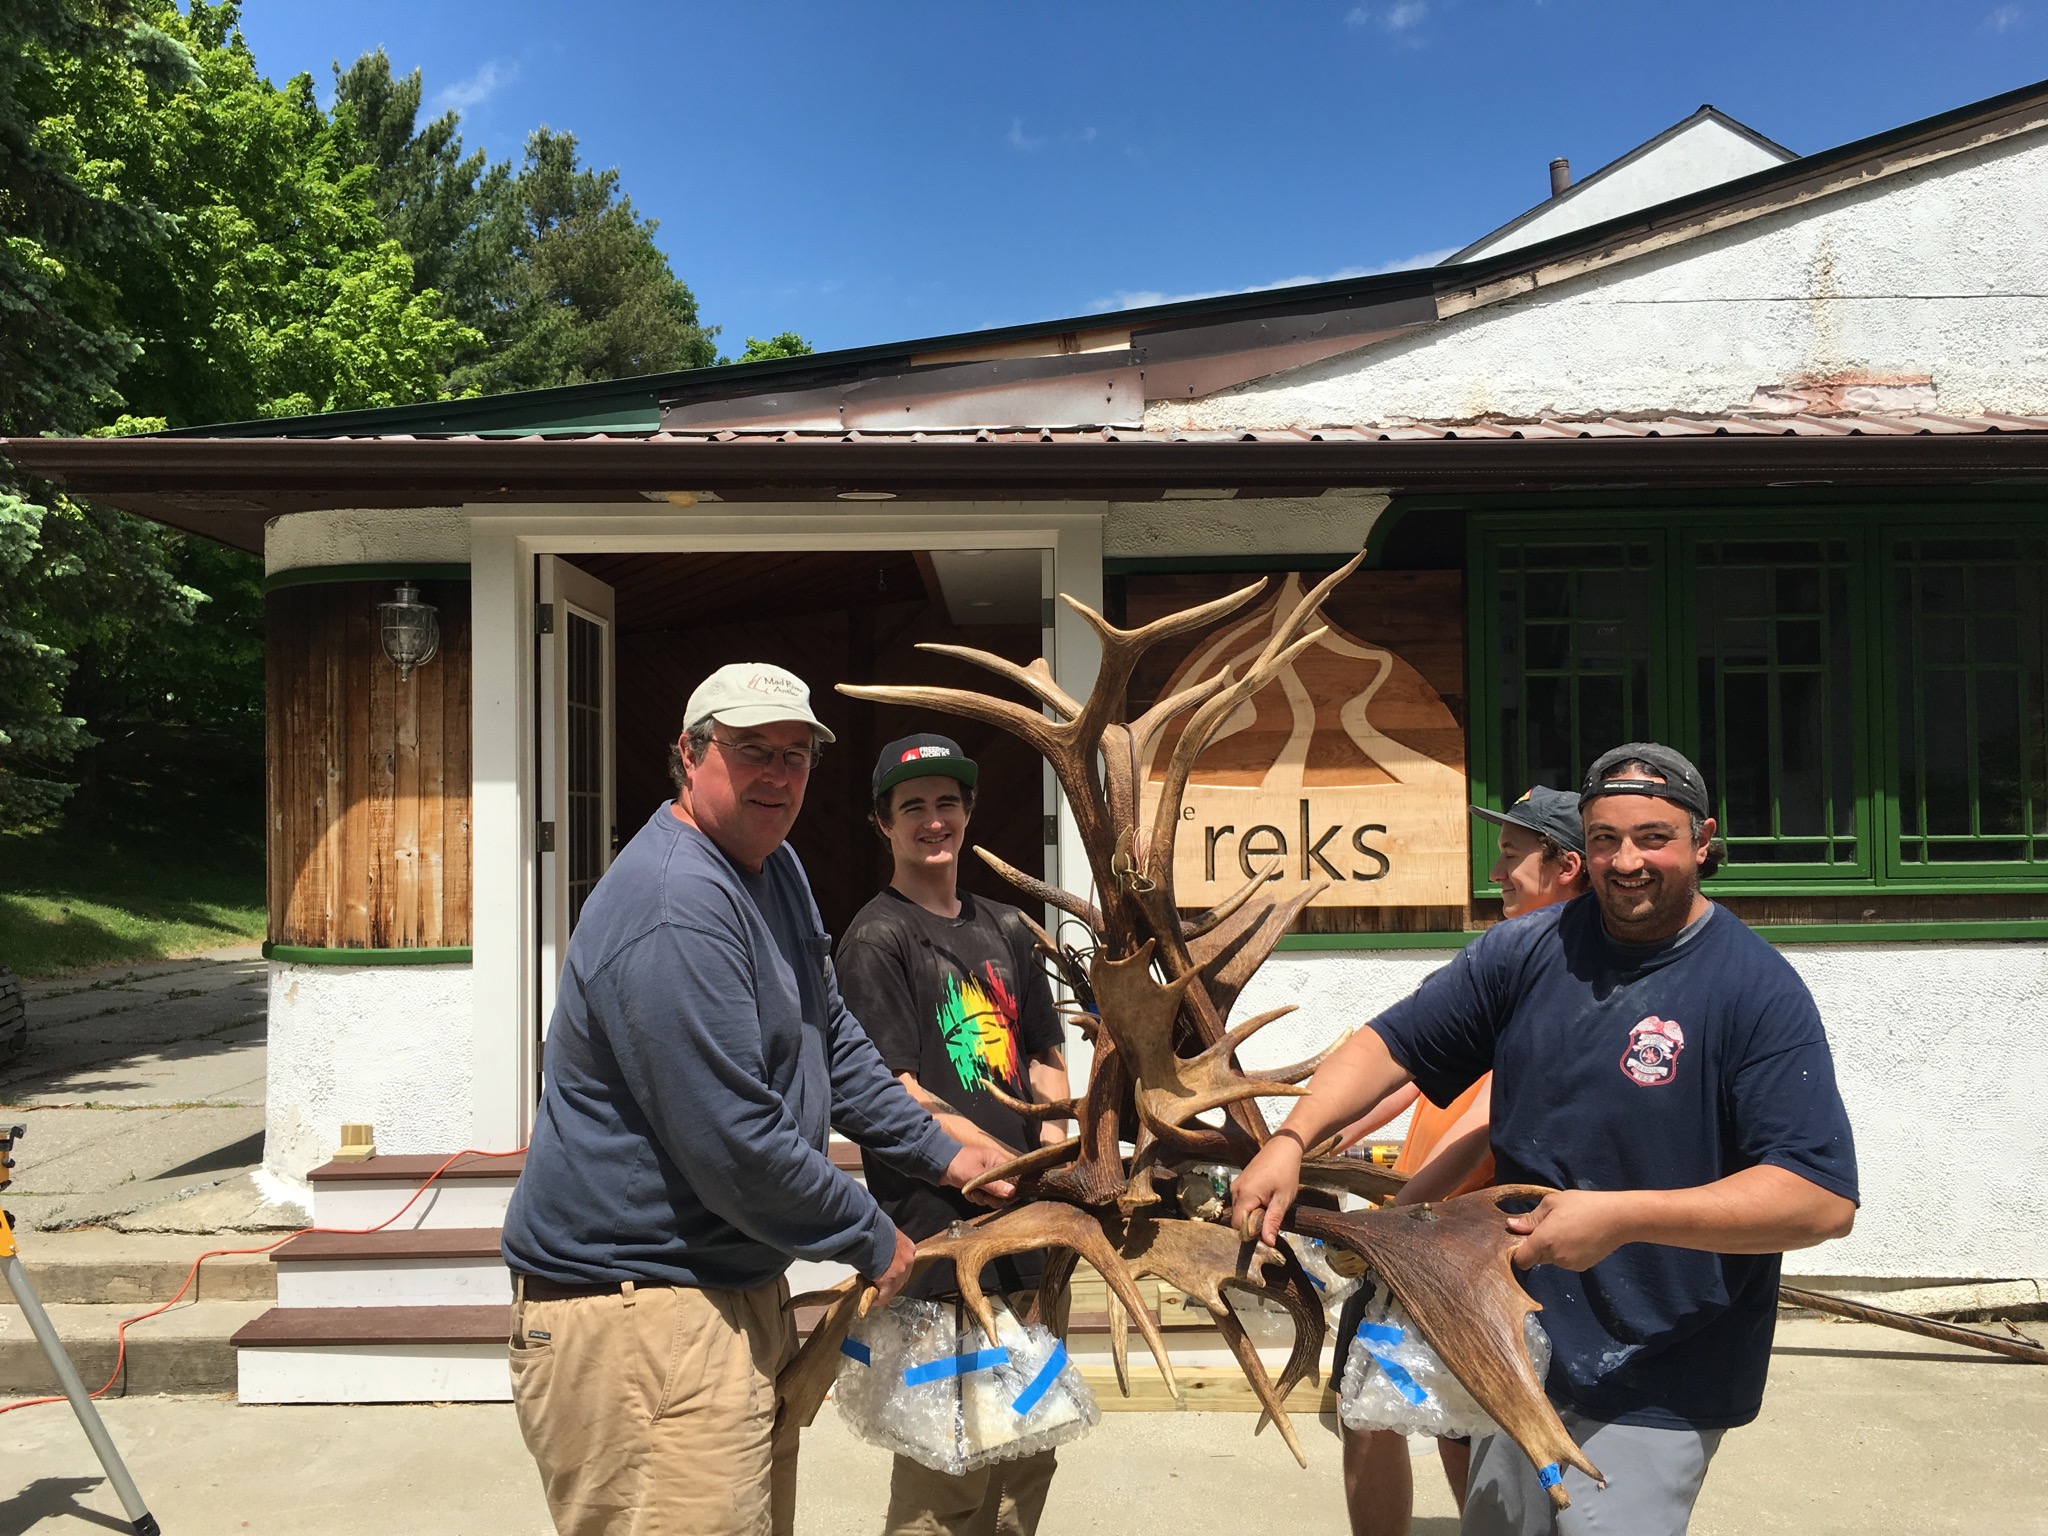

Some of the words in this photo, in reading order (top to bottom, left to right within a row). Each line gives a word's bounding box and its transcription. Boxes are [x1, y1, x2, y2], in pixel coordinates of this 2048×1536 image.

[764, 677, 784, 687] Mad
[1204, 799, 1390, 882] reks
[1634, 1062, 1659, 1073] RESCUE
